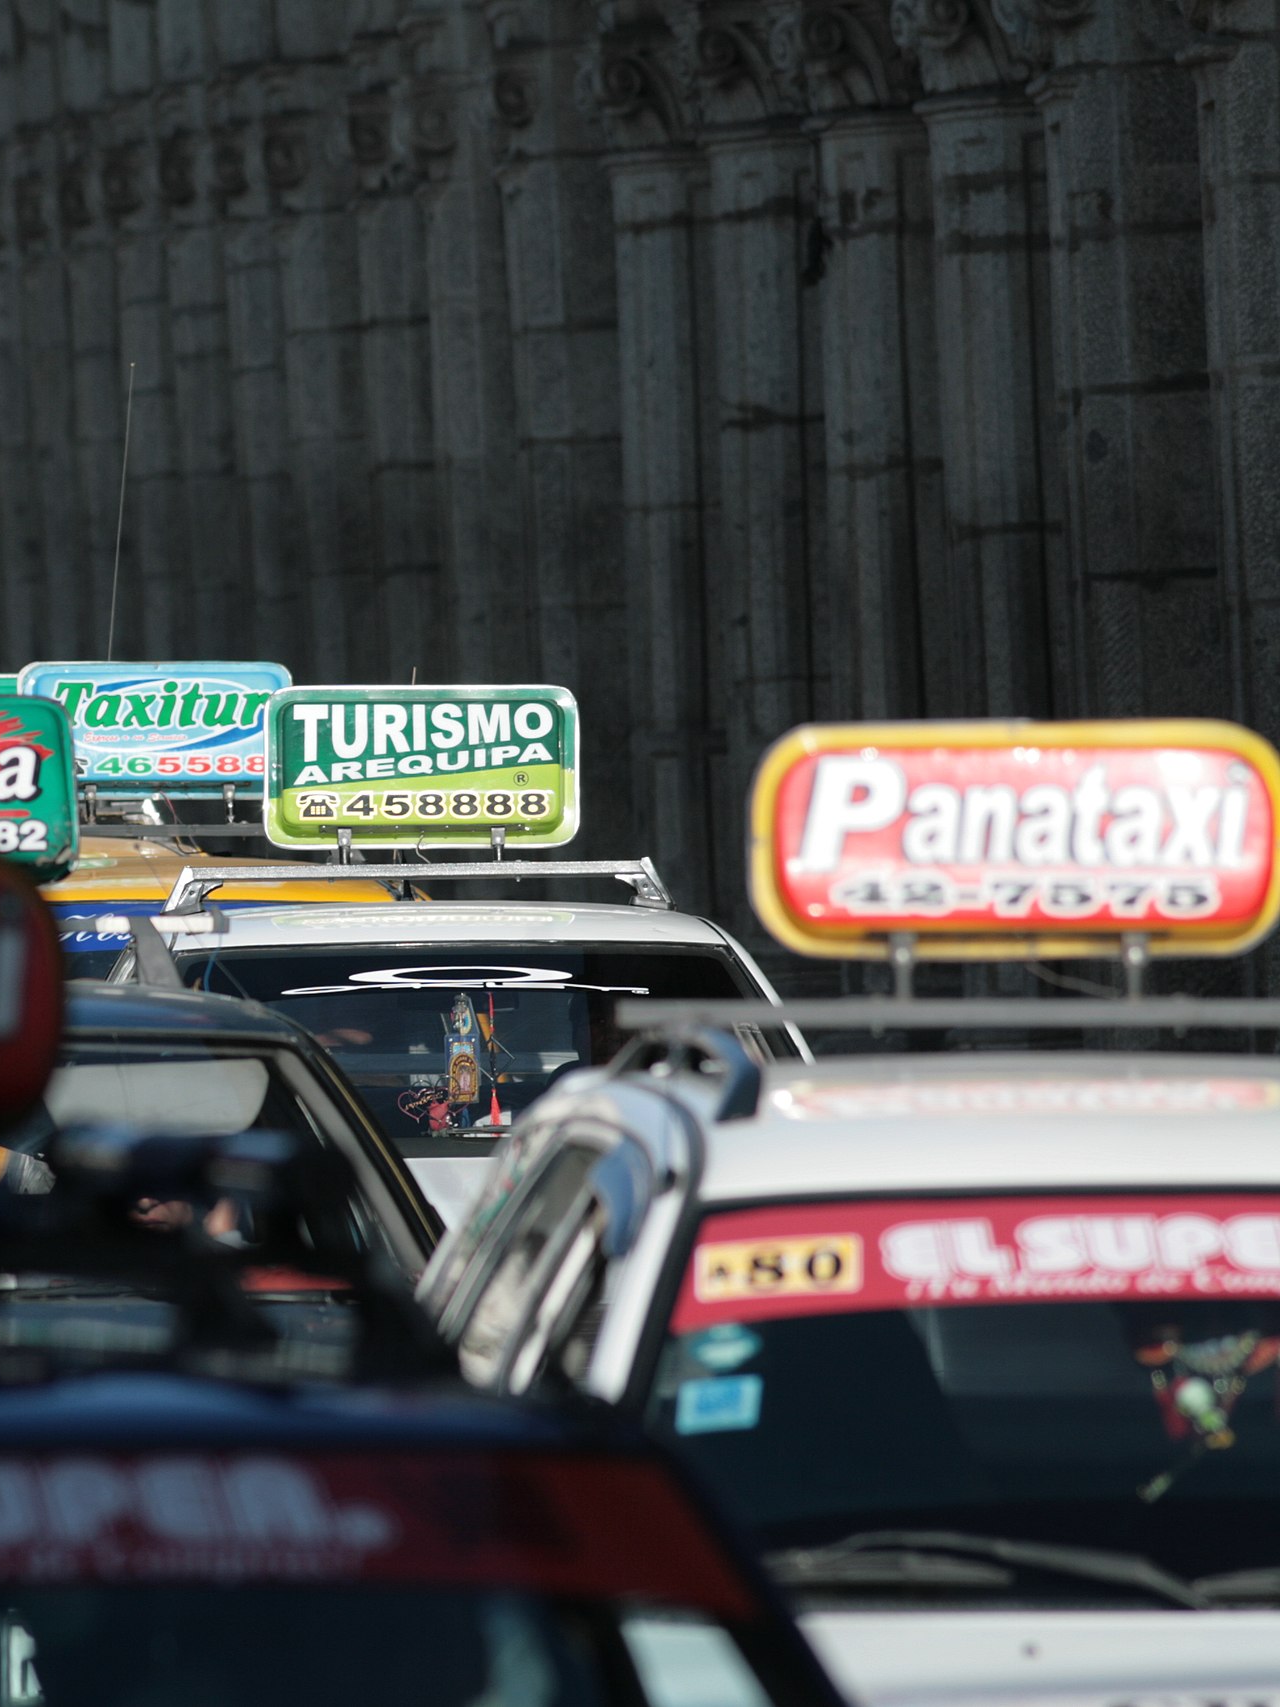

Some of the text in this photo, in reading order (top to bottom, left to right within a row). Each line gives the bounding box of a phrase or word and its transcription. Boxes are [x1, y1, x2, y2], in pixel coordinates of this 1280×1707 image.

[54, 680, 271, 728] Taxitur
[292, 702, 554, 761] TURISMO
[94, 754, 265, 776] 465588
[294, 742, 552, 786] AREQUIPA
[342, 790, 552, 819] 458888
[798, 755, 1252, 872] Panataxi
[829, 869, 1221, 917] 42-7575
[882, 1218, 1015, 1280] EL
